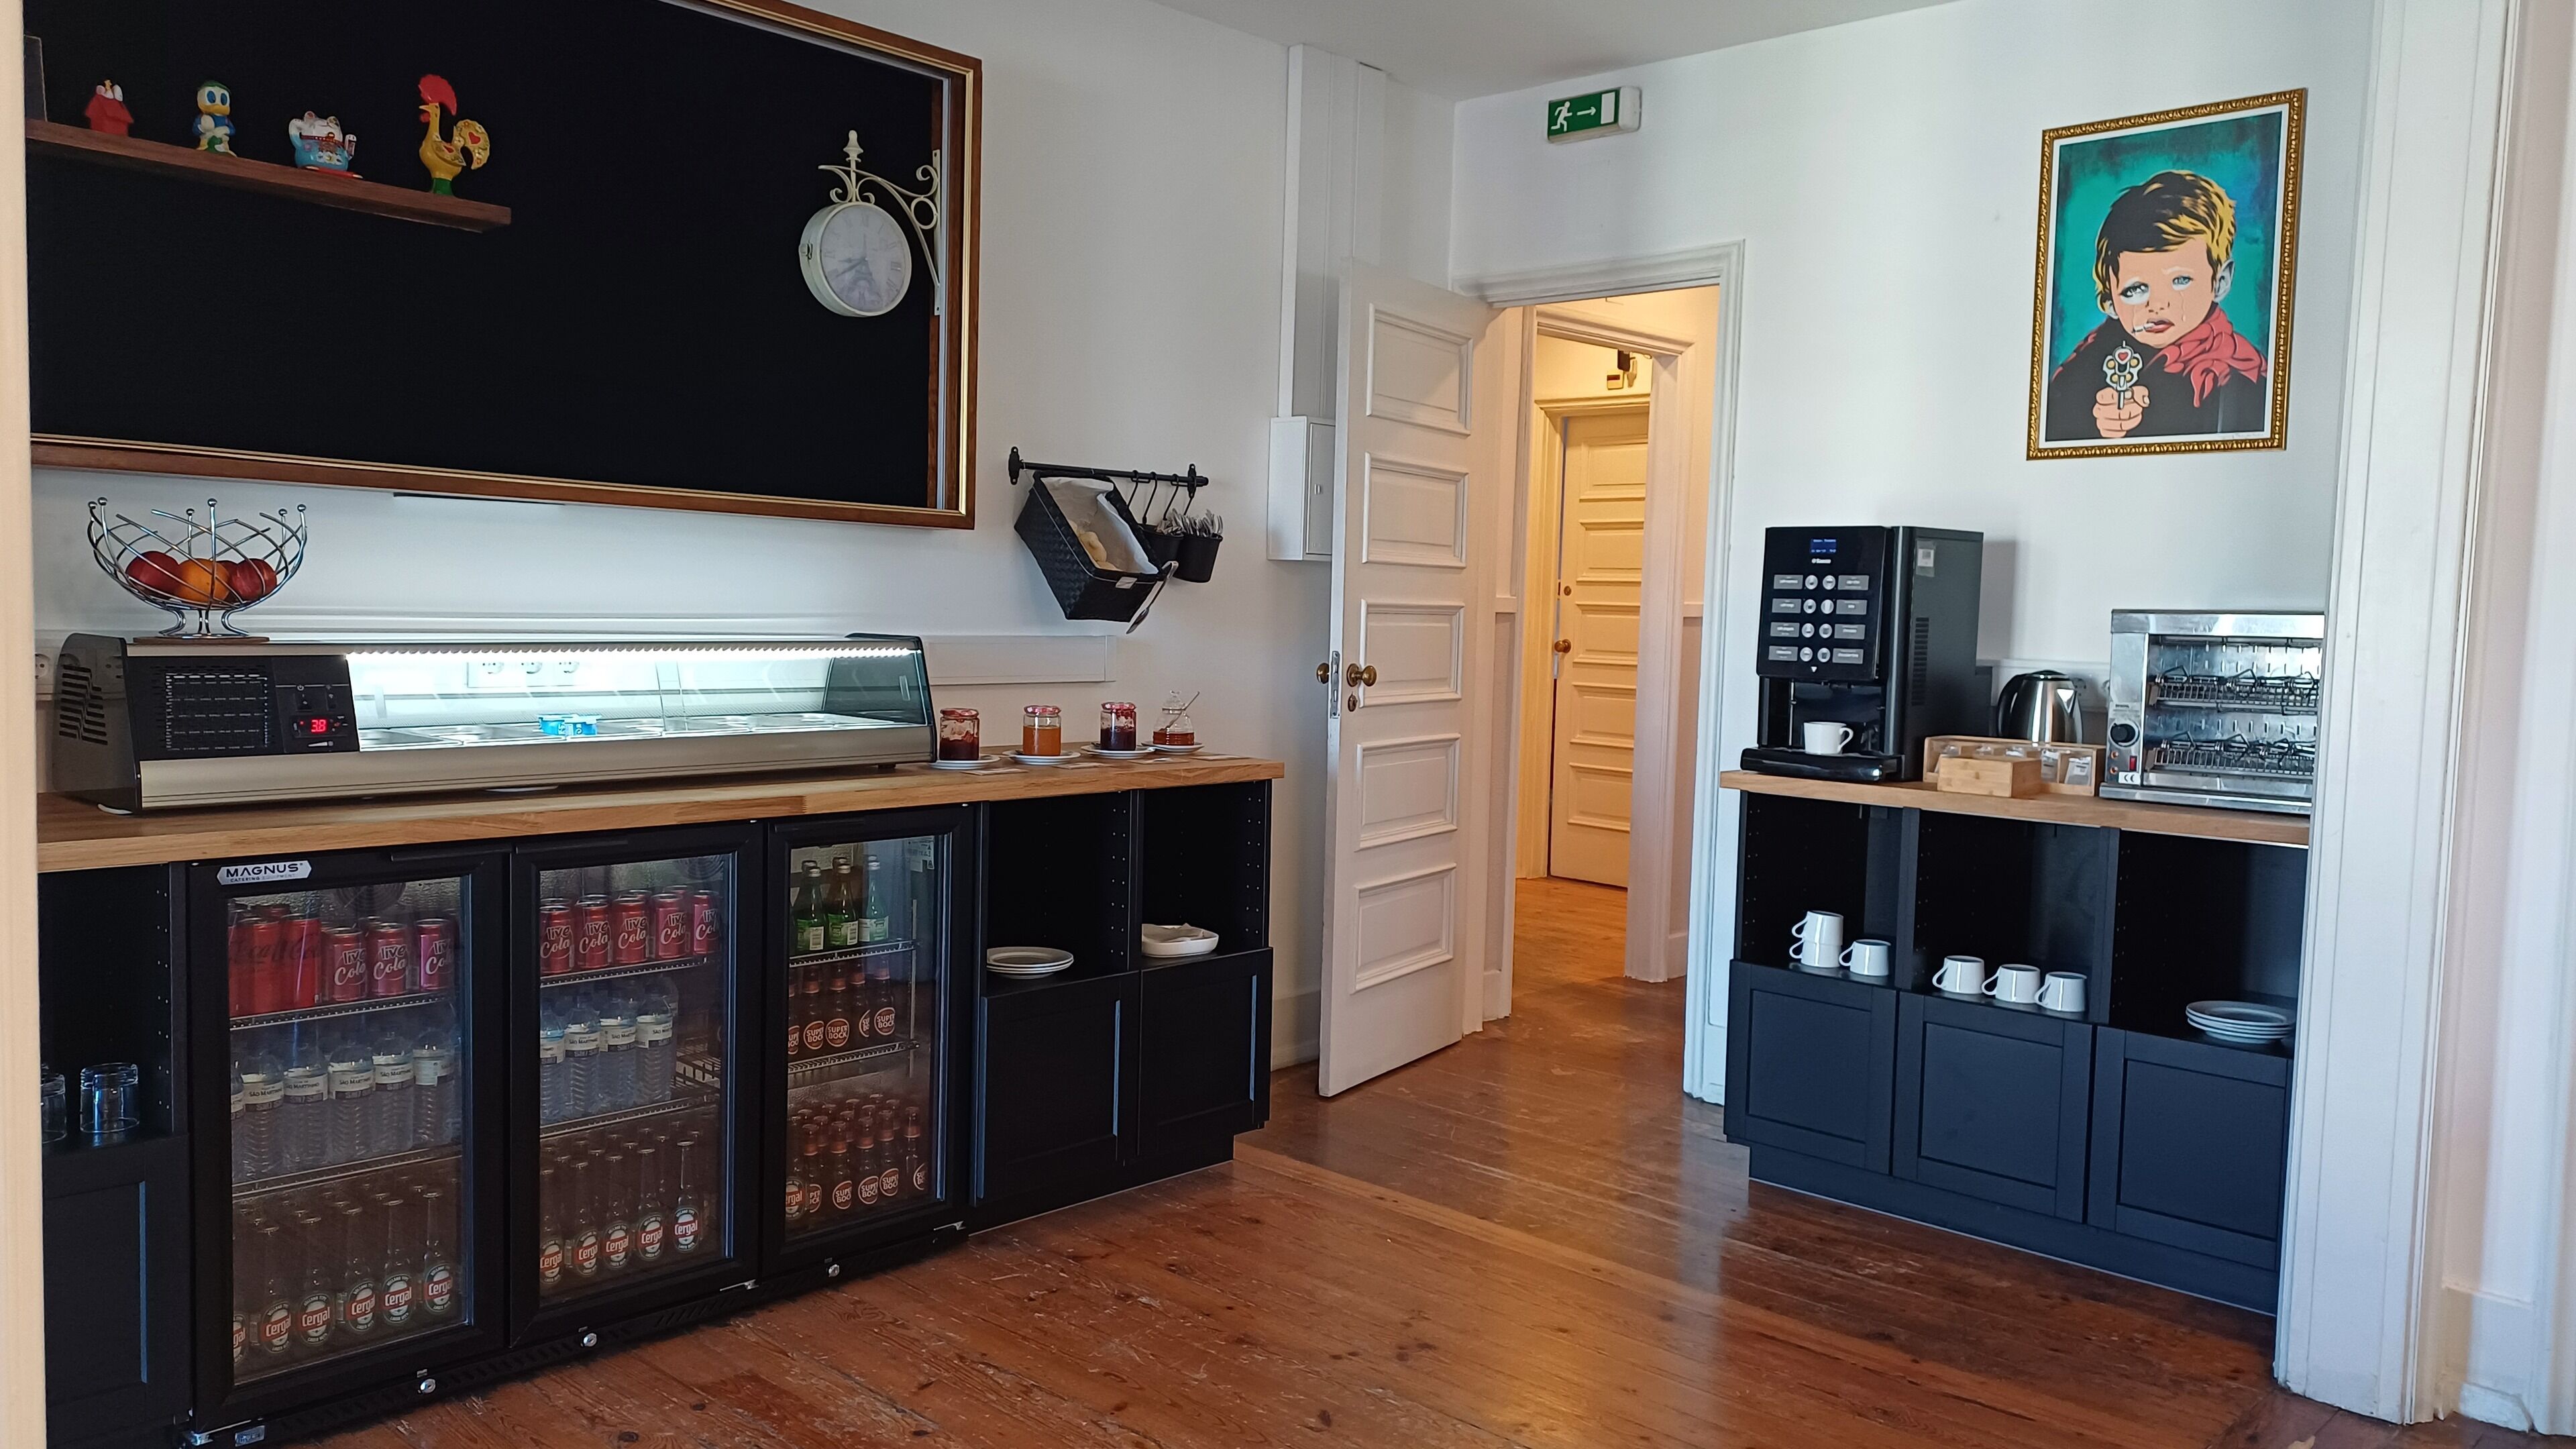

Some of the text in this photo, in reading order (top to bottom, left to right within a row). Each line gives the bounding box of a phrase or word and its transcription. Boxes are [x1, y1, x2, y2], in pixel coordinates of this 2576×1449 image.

[226, 863, 299, 878] MAGNUS
[546, 925, 572, 941] live
[586, 920, 609, 936] live
[625, 916, 647, 932] live
[579, 933, 609, 954] Cola
[617, 928, 647, 949] Cola
[380, 943, 408, 961] live
[540, 938, 570, 959] Cola
[373, 959, 407, 980] Cola
[425, 956, 445, 975] Co
[807, 1034, 824, 1042] BOC
[827, 1025, 848, 1033] SUPER
[861, 1189, 877, 1198] BOC
[883, 1181, 898, 1190] BOC
[786, 1191, 803, 1206] rgal
[836, 1194, 851, 1203] BOC
[641, 1226, 663, 1244] Cergal
[674, 1220, 698, 1236] Cergal
[578, 1244, 598, 1260] Cerga
[606, 1235, 629, 1253] Cergal
[539, 1250, 563, 1269] Cergal
[428, 1276, 453, 1296] Cergal
[351, 1293, 376, 1316] Cergal
[384, 1286, 413, 1307] Cergal
[265, 1313, 291, 1337] Cergal
[302, 1306, 330, 1327] Cergal
[233, 1327, 246, 1348] gal
